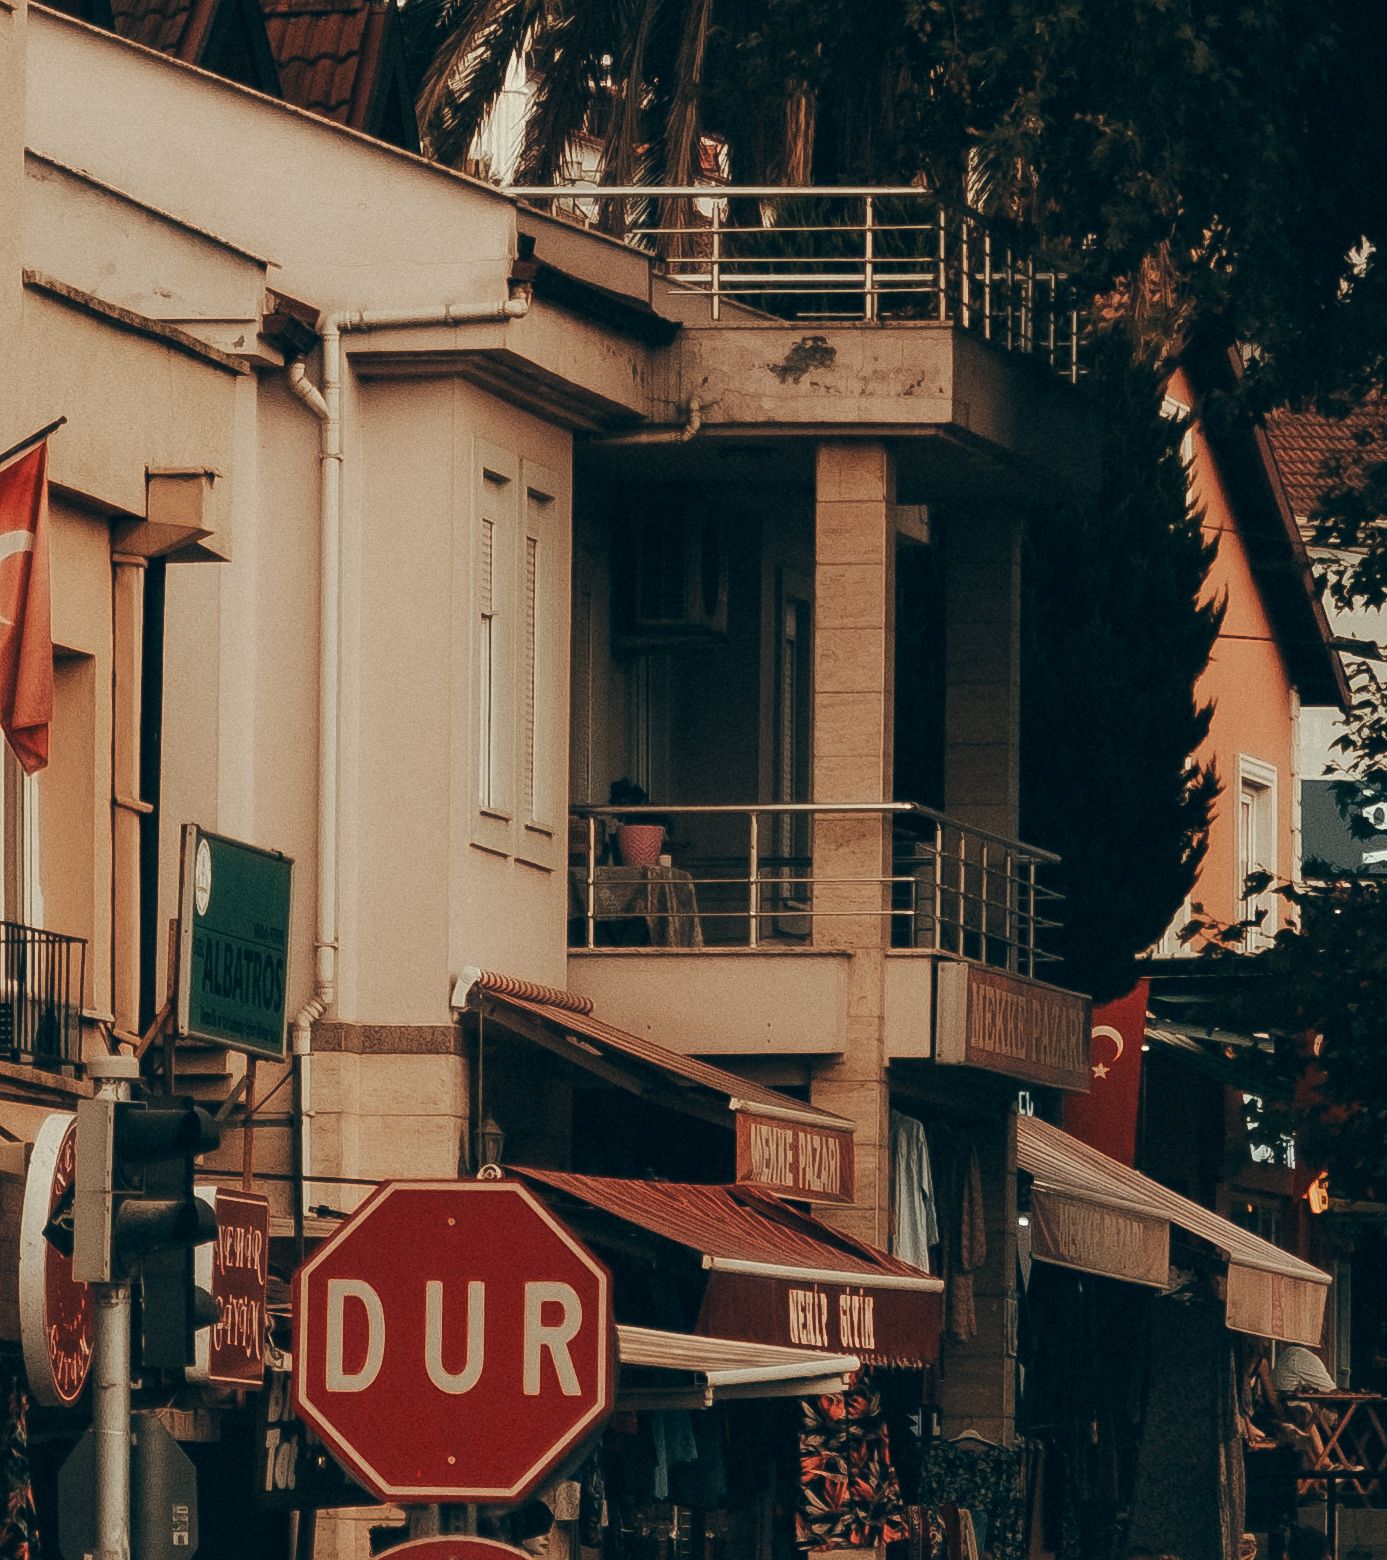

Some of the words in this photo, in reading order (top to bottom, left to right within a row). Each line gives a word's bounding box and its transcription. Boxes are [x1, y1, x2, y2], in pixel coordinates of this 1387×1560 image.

[202, 936, 283, 1014] ALBATROS
[798, 1130, 841, 1195] PAZARI
[326, 1278, 583, 1397] DUR
